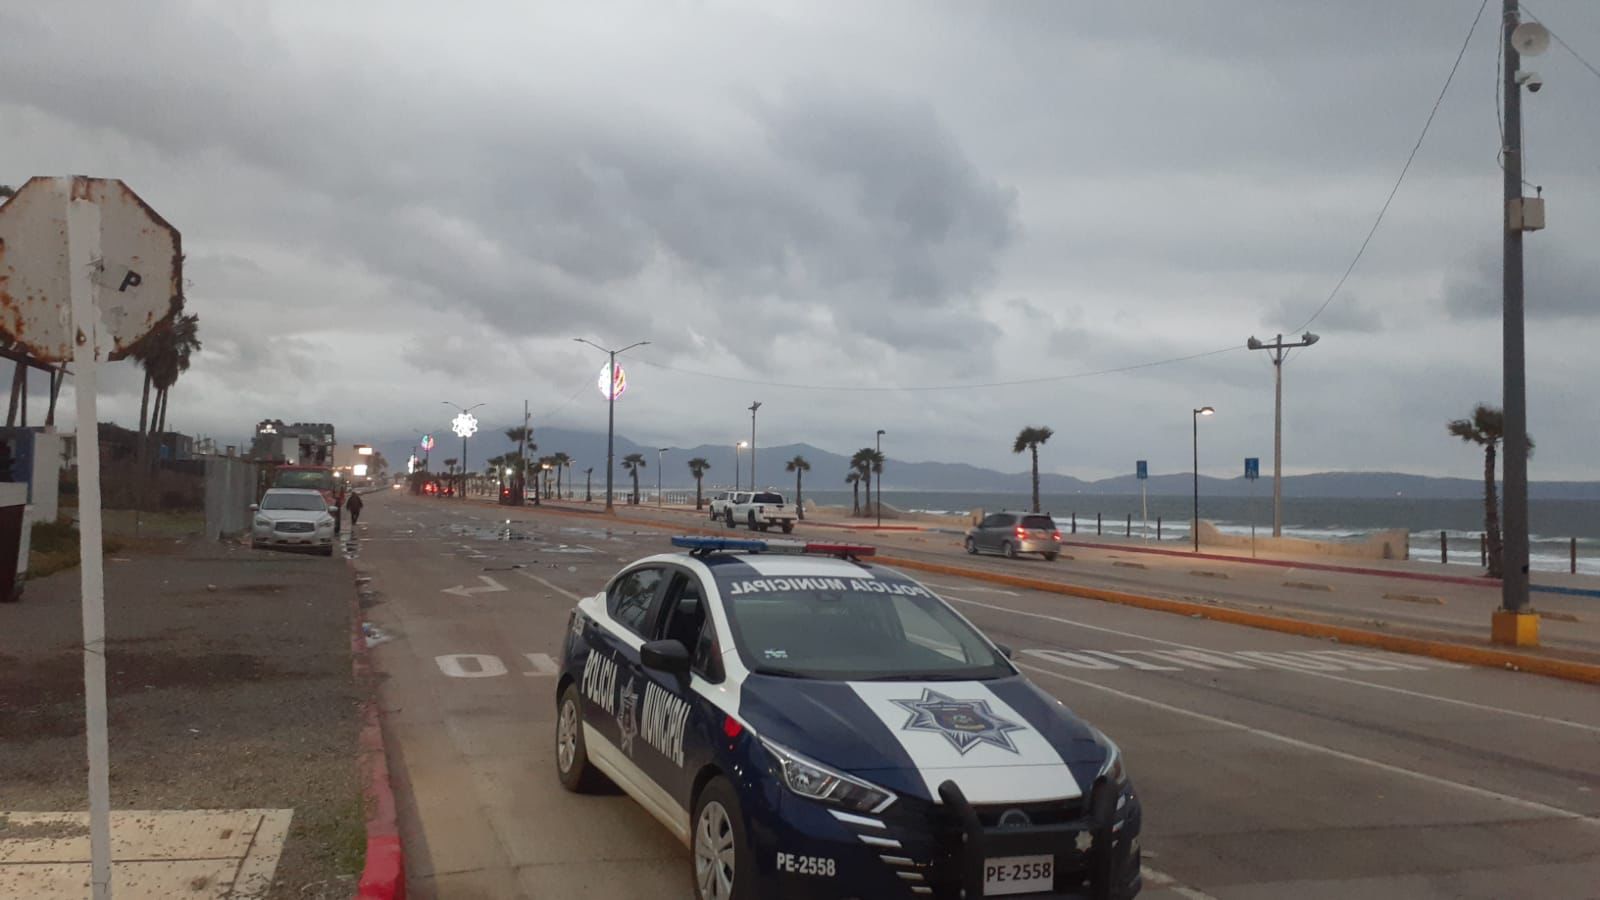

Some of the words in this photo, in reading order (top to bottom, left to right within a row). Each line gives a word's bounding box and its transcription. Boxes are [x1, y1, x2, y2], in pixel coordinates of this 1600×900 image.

[641, 680, 692, 768] MUNICIPAL
[776, 852, 836, 877] PE-2558
[986, 862, 1051, 882] PE-2558
